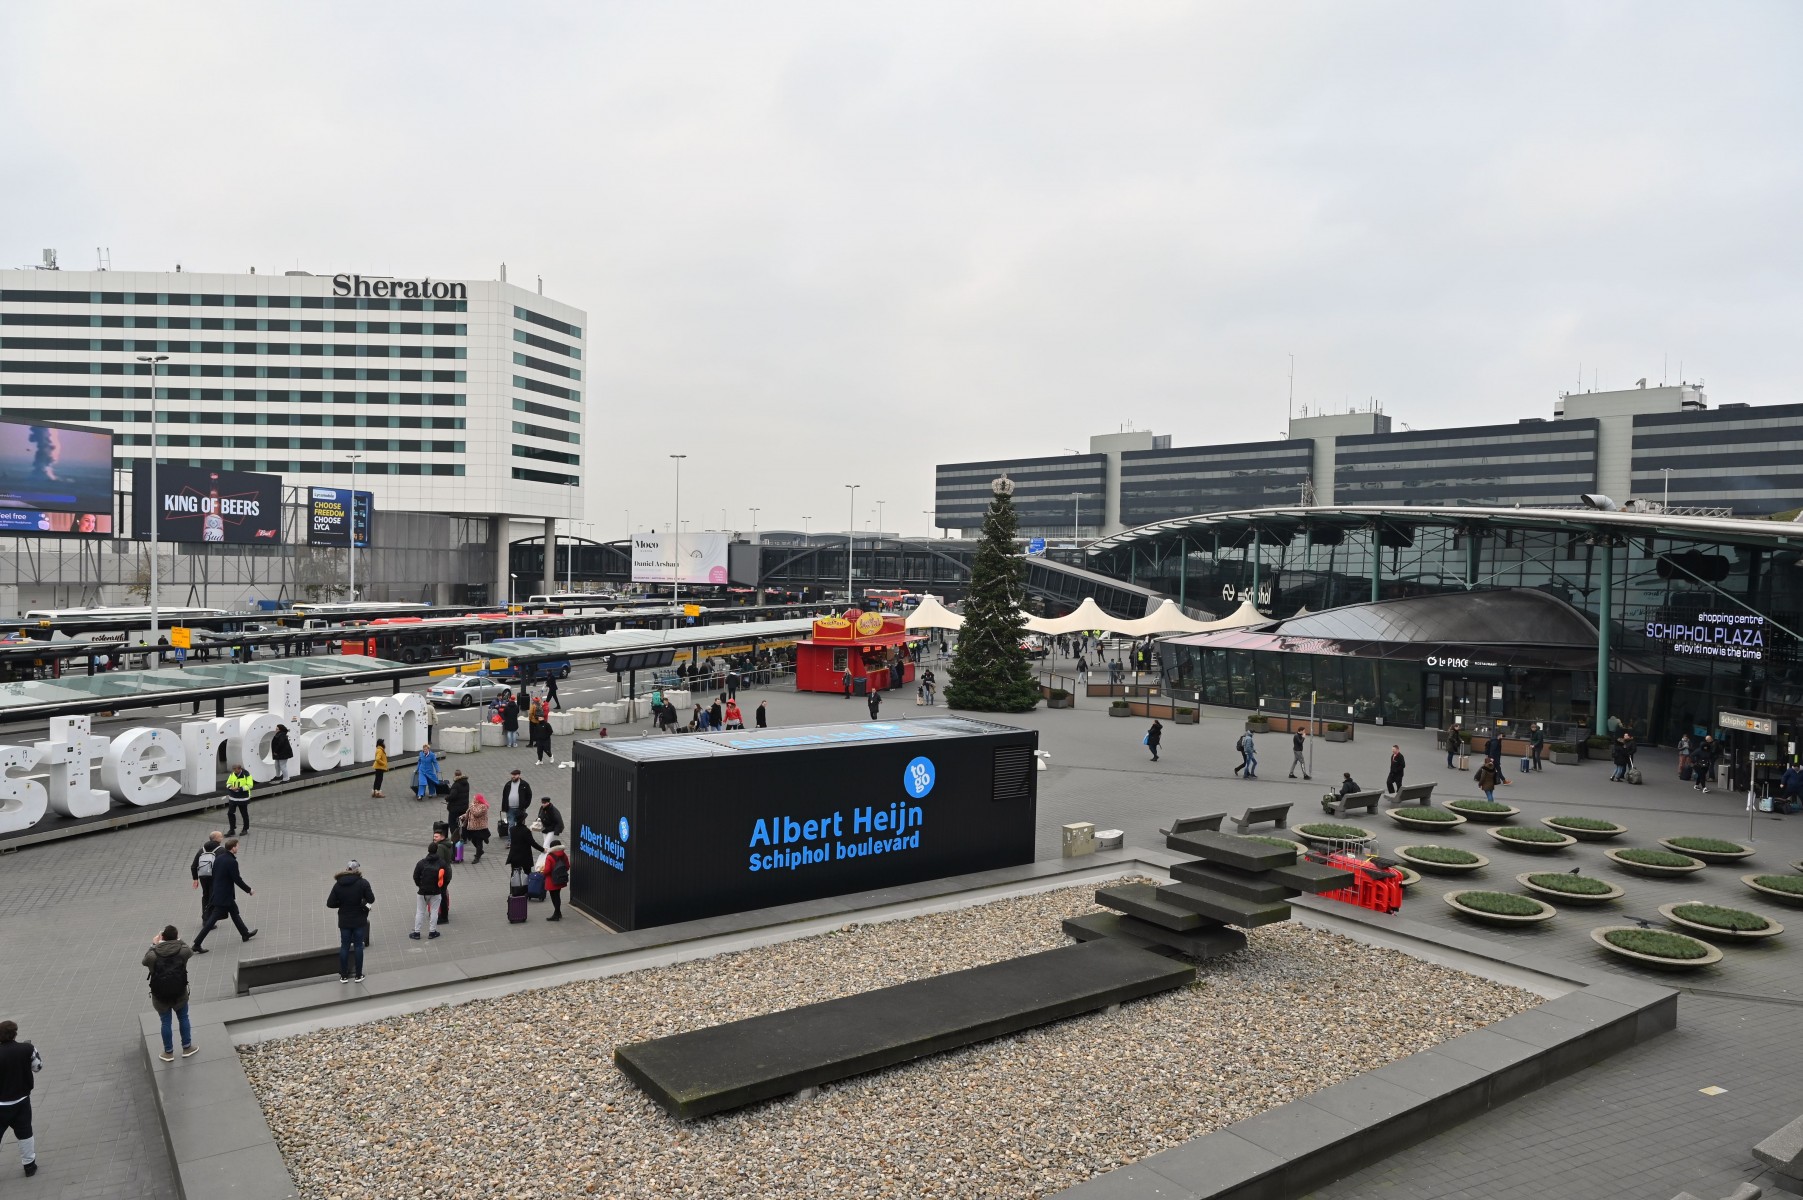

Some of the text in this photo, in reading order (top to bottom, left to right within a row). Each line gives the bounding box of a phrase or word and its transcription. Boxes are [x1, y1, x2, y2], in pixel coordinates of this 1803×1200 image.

[332, 273, 468, 299] Sheraton
[164, 494, 260, 516] KING OF BEERS
[314, 501, 341, 509] CHOOSE
[314, 508, 345, 517] FREEDOM
[0, 512, 27, 520] eel free
[314, 516, 341, 524] CHOOSE
[634, 540, 659, 549] Moco
[1698, 612, 1764, 625] shopping centre
[1646, 622, 1764, 647] SCHIPHOL PLAZA
[1674, 643, 1693, 655] enjoy
[1702, 646, 1719, 656] now
[1719, 646, 1726, 656] is
[1727, 647, 1741, 658] the
[1741, 648, 1762, 660] time
[1439, 657, 1446, 667] La
[1447, 657, 1469, 668] PLACE
[1721, 715, 1746, 727] Schiphol
[910, 763, 925, 779] to
[914, 773, 930, 793] go
[749, 801, 923, 848] Albert Heijn
[580, 824, 625, 860] Albert Heijn
[580, 840, 600, 860] Schiphol
[749, 830, 920, 872] Schiphol boulevard
